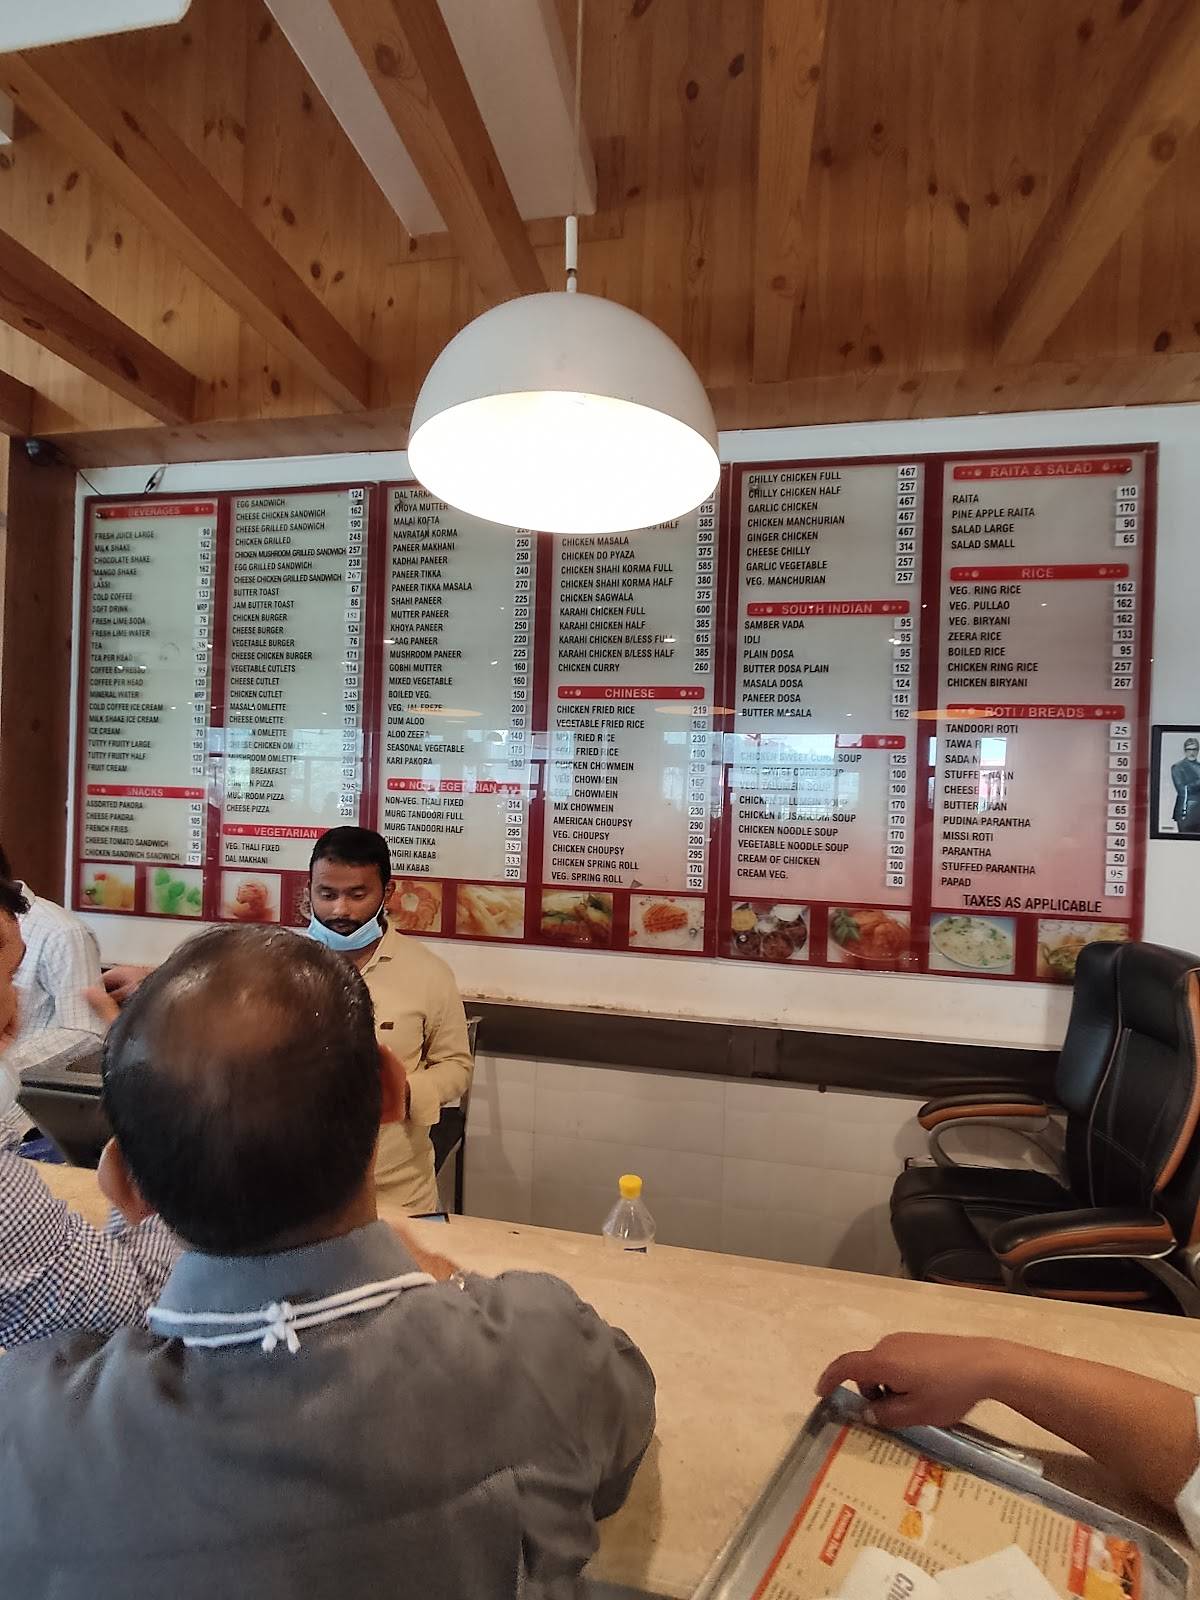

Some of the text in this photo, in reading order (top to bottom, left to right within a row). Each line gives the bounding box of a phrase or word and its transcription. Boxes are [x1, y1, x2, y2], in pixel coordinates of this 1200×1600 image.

[989, 463, 1092, 476] RAITA & SALAD
[1119, 487, 1136, 496] 110
[899, 497, 915, 506] 467
[952, 494, 979, 503] RAITA
[128, 506, 180, 516] BEVERAGES
[350, 506, 362, 515] 162
[748, 502, 818, 513] GARLIC CHICKEN
[1118, 503, 1135, 512] 170
[236, 509, 326, 520] CHEESE CHICKEN SANDWICH
[898, 512, 914, 521] 467
[952, 507, 1035, 518] PINE APPLE RAITA
[350, 519, 361, 528] 190
[747, 516, 845, 527] CHICKEN MANCHURIAN
[235, 522, 325, 534] CHEESE GRILLED SANDWICH
[561, 537, 629, 546] CHICKEN MASALA
[698, 533, 712, 542] 590
[1122, 535, 1135, 543] 65
[392, 542, 455, 552] PANEER MAKHANI
[516, 539, 529, 547] 250
[951, 539, 1015, 549] SALAD SMALL
[561, 550, 635, 560] CHICKEN DO PYAZA
[698, 547, 712, 556] 375
[392, 556, 448, 565] KADHAI PANEER
[516, 552, 529, 561] 250
[746, 560, 828, 571] GARLIC VEGETABLE
[897, 558, 913, 566] 257
[1021, 568, 1052, 578] RICE
[515, 580, 528, 589] 270
[560, 577, 673, 588] CHICKEN SHAHI KORMA HALF
[697, 576, 711, 585] 380
[391, 582, 472, 592] PANEER TIKKA MASALA
[391, 596, 442, 605] SHAHI PANEER
[514, 595, 528, 603] 225
[1116, 599, 1132, 608] 162
[781, 603, 872, 614] SOUTH INDIAN
[949, 601, 1010, 610] VEG. PULLAO
[390, 623, 443, 632] KHOYA PANEER
[514, 621, 527, 630] 250
[559, 621, 646, 630] KARAHI CHICKEN HALF
[695, 619, 710, 628] 385
[231, 652, 312, 660] CHEESE CHICKEN BURGER
[346, 650, 358, 659] 171
[389, 650, 462, 658] MUSHROOM PANEER
[513, 649, 526, 657] 225
[743, 649, 795, 658] PLAIN DOSA
[900, 649, 911, 657] 95
[558, 664, 620, 672] CHICKEN CURRY
[694, 662, 709, 671] 260
[743, 664, 829, 673] BUTTER DOSA PLAIN
[895, 664, 910, 672] 152
[230, 677, 280, 685] CHEESE CUTLET
[344, 677, 356, 686] 133
[947, 678, 1028, 687] CHICKEN BIRYANI
[1114, 678, 1131, 687] 267
[604, 689, 655, 698] CHINESE
[89, 702, 164, 712] COLD COFFEE ICE CREAM
[556, 705, 635, 714] CHICKEN FRIED RICE
[693, 706, 707, 715] 219
[946, 724, 1018, 733] TANDOORI ROTI
[1114, 726, 1128, 735] 25
[386, 757, 433, 765] KARI PAKORA
[127, 787, 163, 797] SNACKS
[226, 804, 270, 814] CHEESE PIZZA
[340, 808, 353, 817] 238
[553, 816, 633, 827] AMERICAN CHOUPSY
[689, 821, 703, 830] 290
[254, 827, 317, 837] VEGETARIAN
[384, 823, 465, 834] MURG TANDOORI HALF
[507, 828, 520, 836] 295
[738, 825, 839, 836] CHICKEN NOODLE SOUP
[890, 831, 904, 839] 170
[943, 831, 994, 841] MISSI ROTI
[85, 836, 169, 848] CHEESE TOMATO SANDWICH
[1113, 839, 1125, 847] 40
[225, 842, 280, 852] VEG. THALI FIXED
[225, 854, 268, 864] DAL MAKHANI
[737, 854, 820, 865] CREAM OF CHICKEN
[552, 858, 639, 870] CHICKEN SPRING ROLL
[889, 861, 903, 870] 100
[506, 869, 519, 878] 320
[689, 865, 702, 873] 170
[737, 868, 789, 879] CREAM VEG.
[892, 876, 903, 885] 80
[941, 877, 971, 887] PAPAD
[1112, 885, 1124, 894] 10
[963, 894, 1102, 912] TAXES AS APPLICABLE
